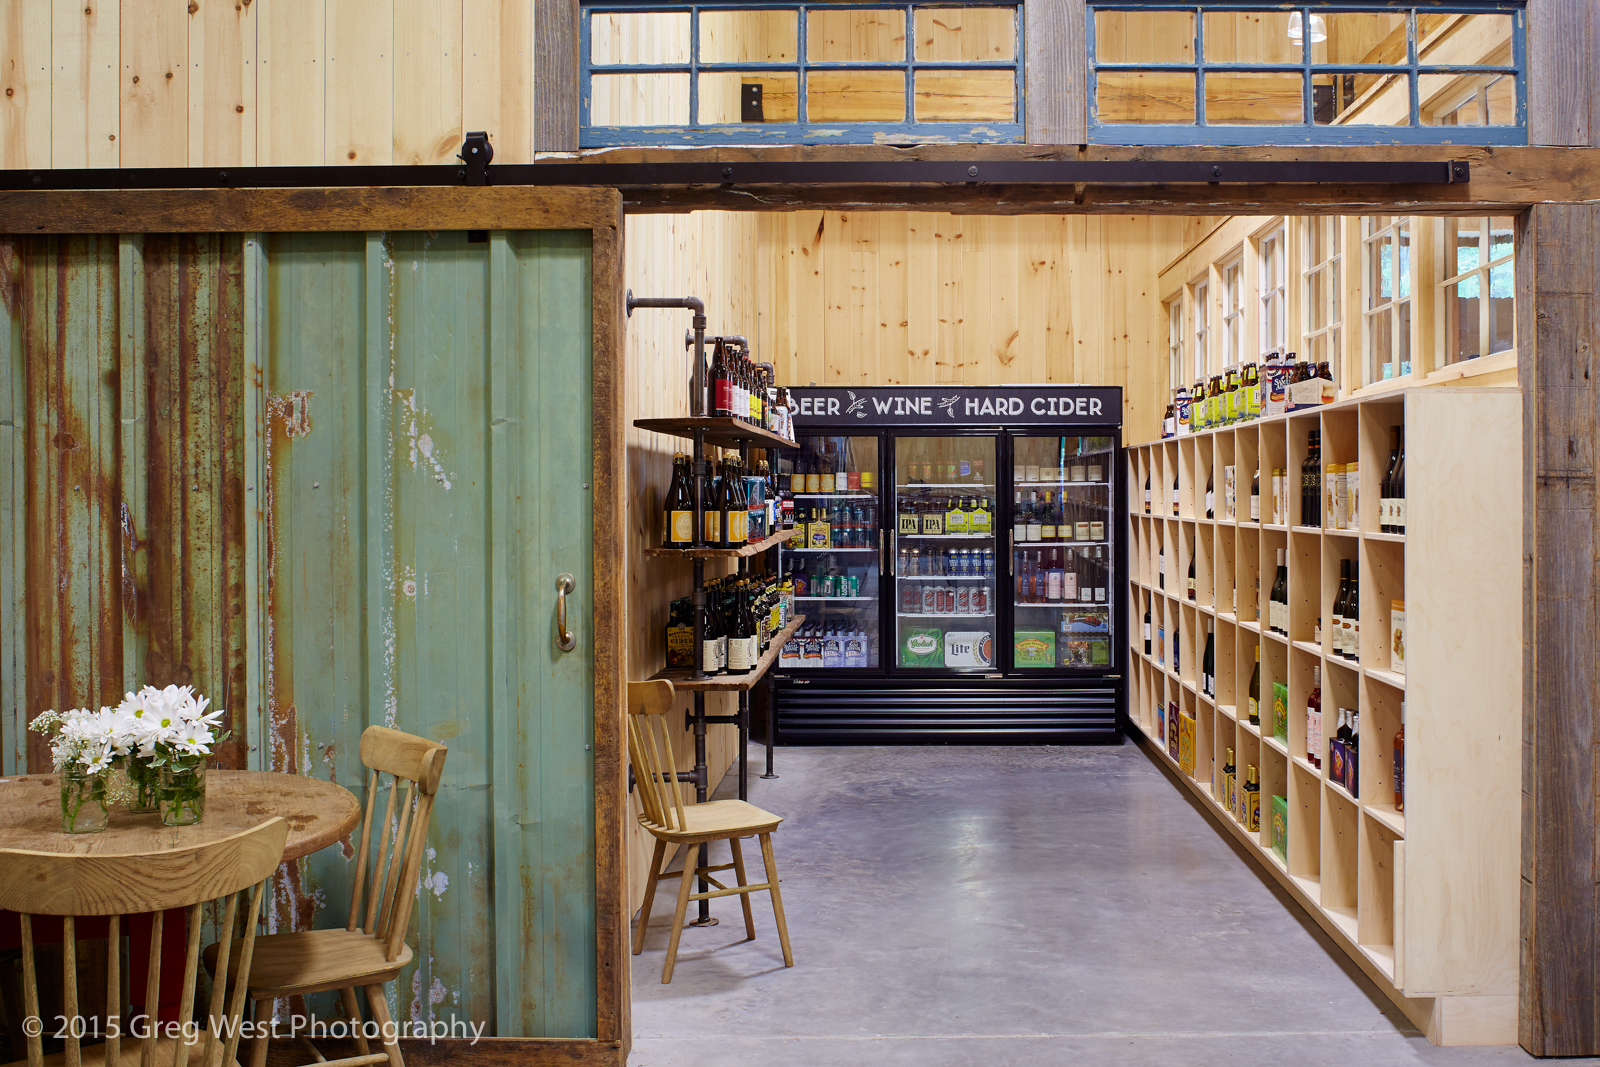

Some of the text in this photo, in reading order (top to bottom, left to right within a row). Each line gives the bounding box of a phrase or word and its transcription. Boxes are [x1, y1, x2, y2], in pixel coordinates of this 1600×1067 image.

[790, 397, 840, 416] BEER
[872, 397, 932, 416] WINE
[965, 397, 1102, 416] HARD CIDER
[901, 519, 916, 529] IPA
[925, 519, 940, 529] IPA
[951, 643, 970, 656] Lite
